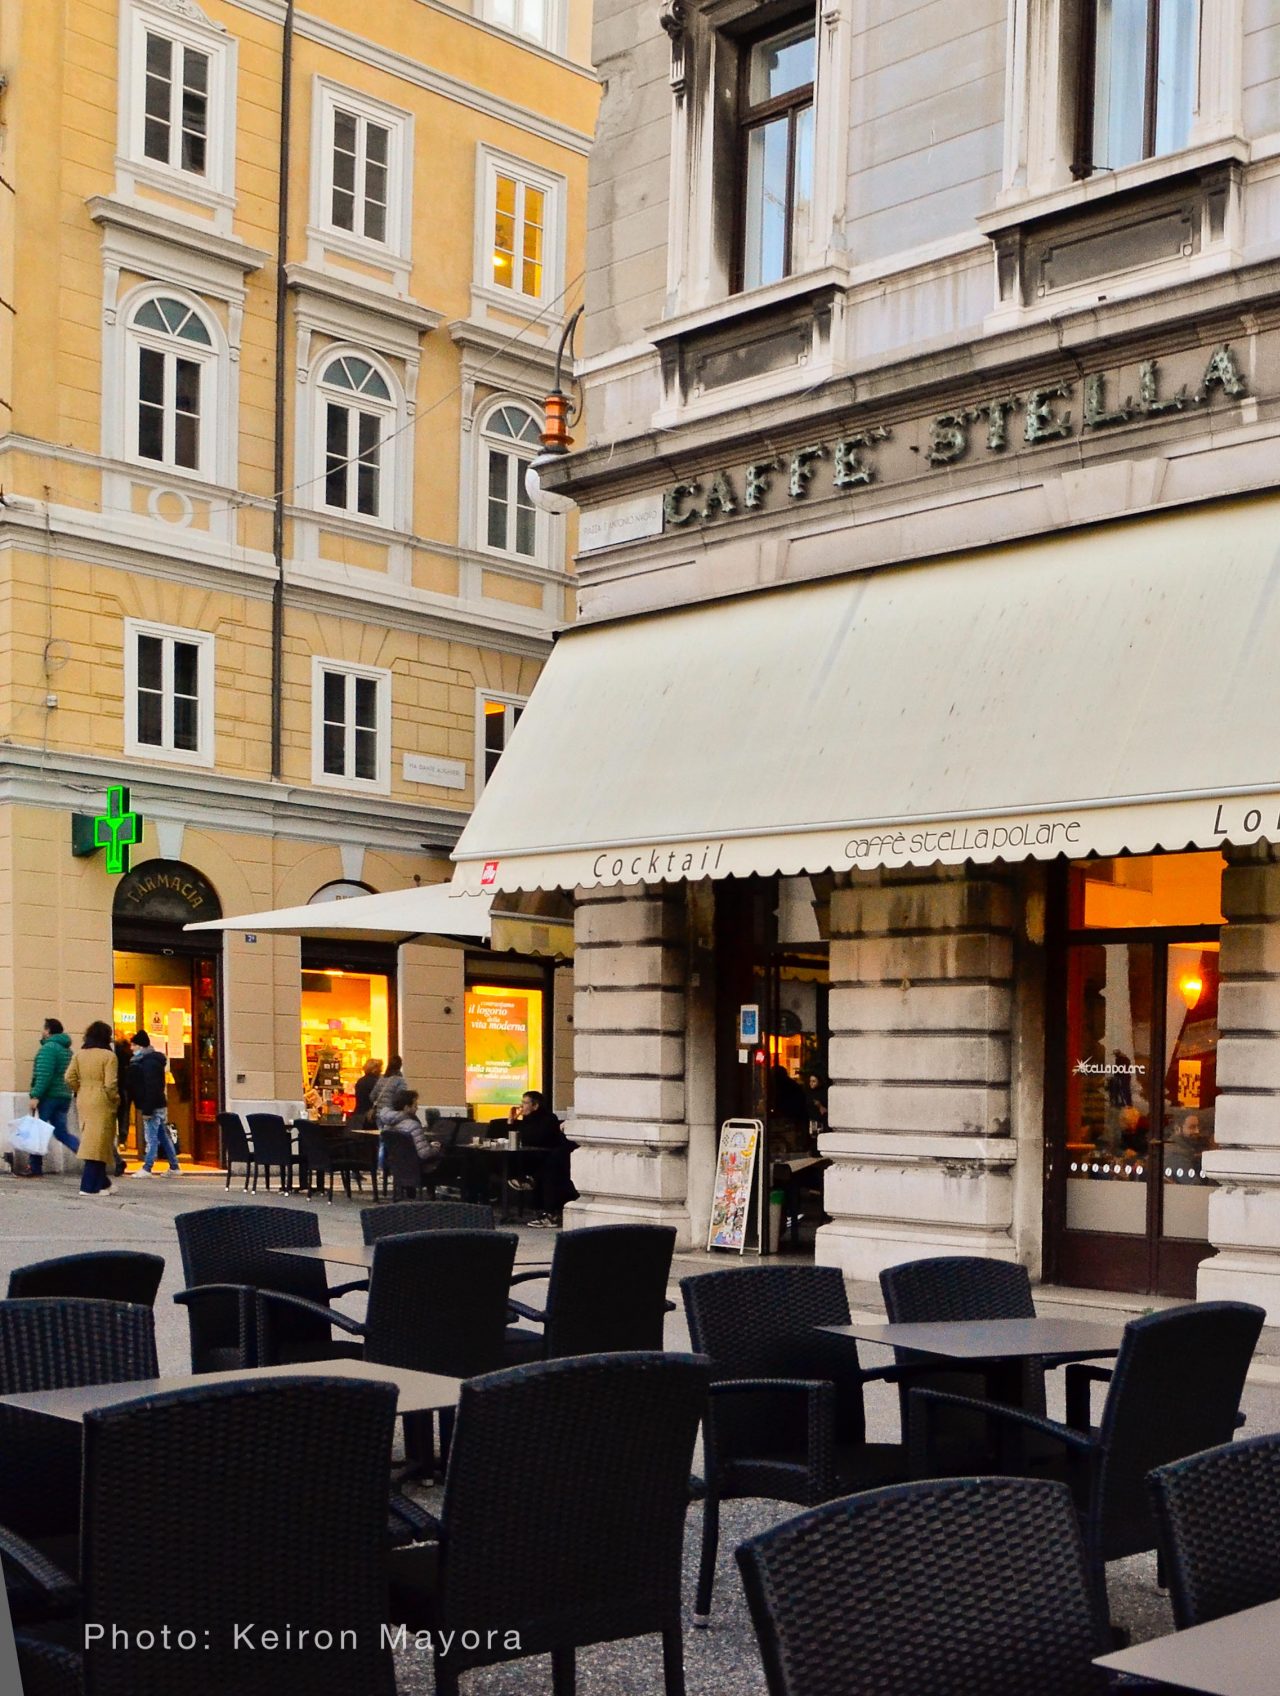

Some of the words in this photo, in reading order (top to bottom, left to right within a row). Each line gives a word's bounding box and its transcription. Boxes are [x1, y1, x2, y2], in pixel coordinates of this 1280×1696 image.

[925, 342, 1247, 468] STELLA
[593, 843, 724, 878] Cocktail
[844, 831, 904, 859] caffè
[127, 873, 204, 909] FARMACIA
